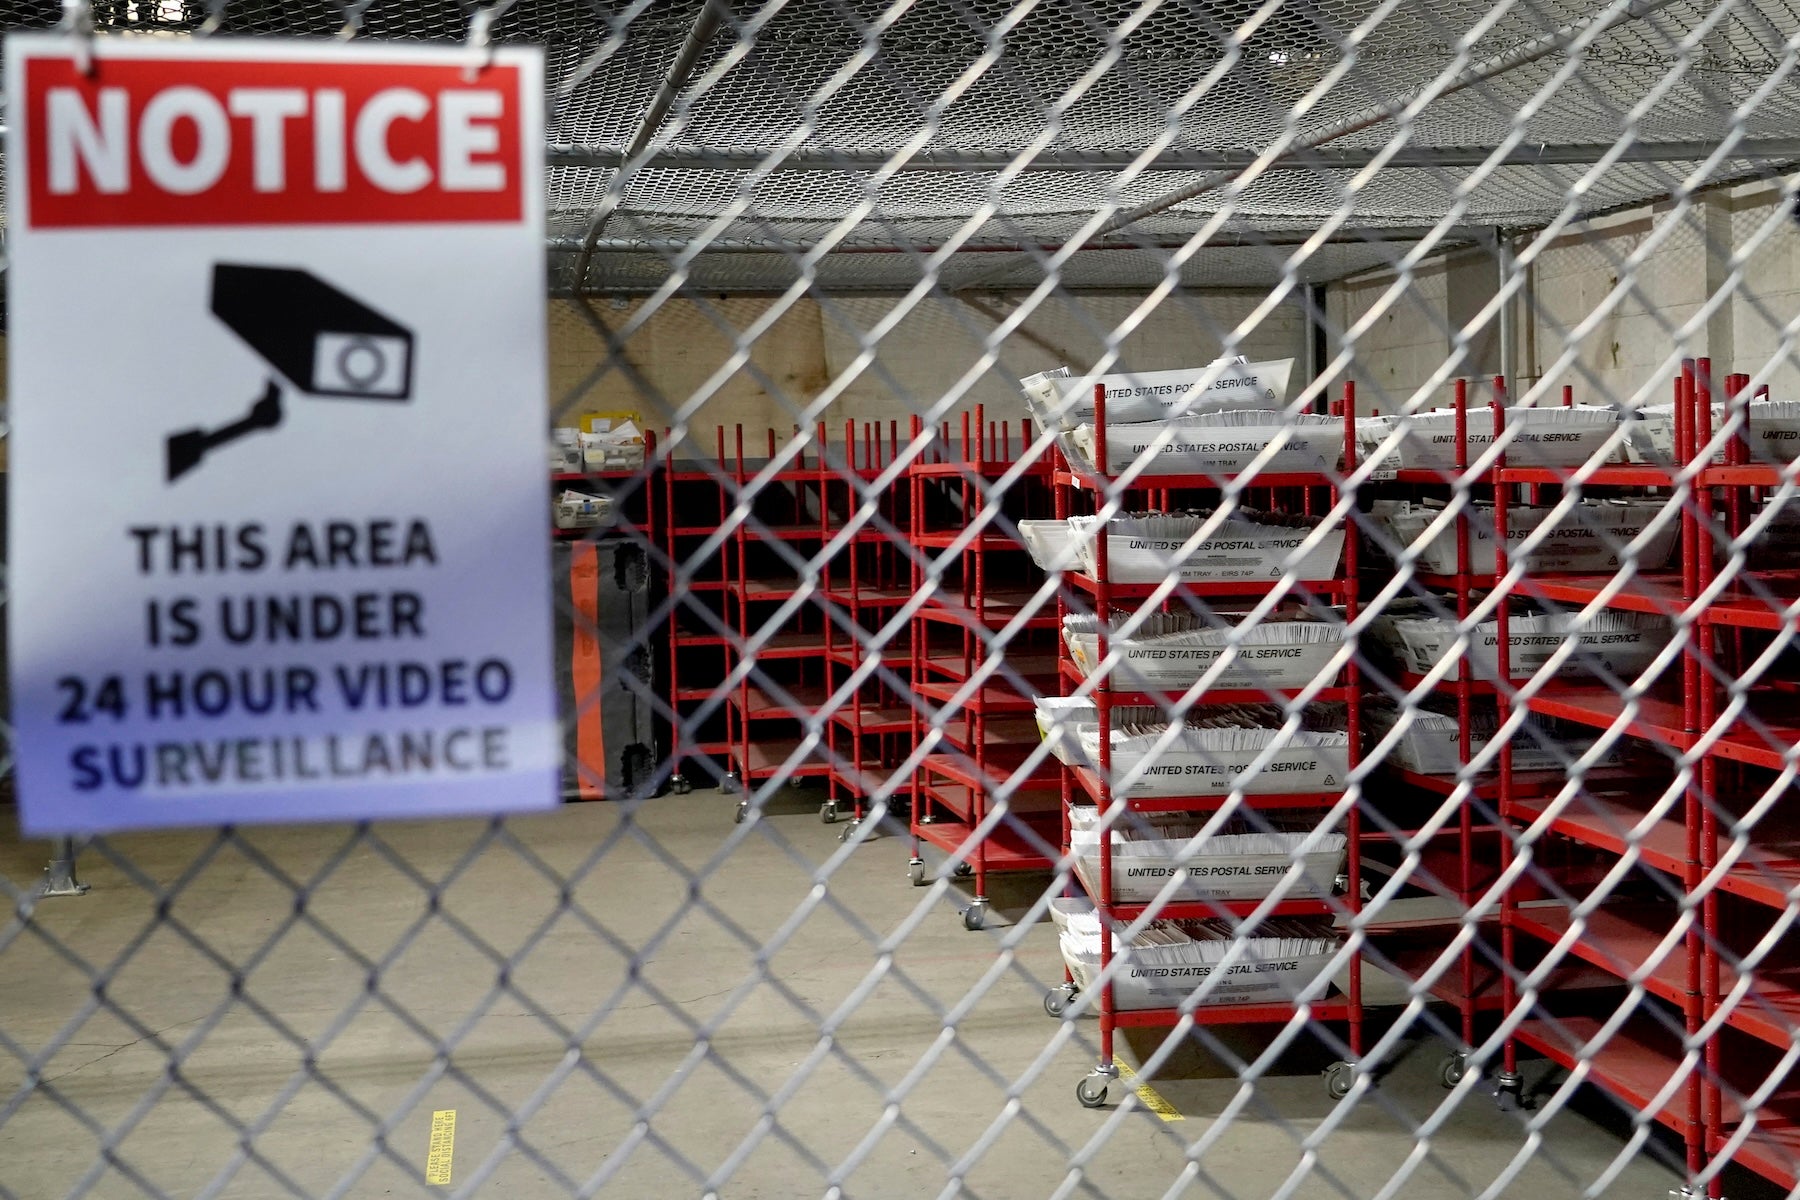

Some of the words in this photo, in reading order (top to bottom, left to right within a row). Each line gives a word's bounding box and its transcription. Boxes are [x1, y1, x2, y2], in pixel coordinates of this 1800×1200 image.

[45, 86, 507, 195] NOTICE
[1135, 386, 1172, 396] STATES
[1216, 376, 1258, 389] SERVICE
[1542, 433, 1583, 442] SERVICE
[1762, 431, 1797, 440] UNITED
[1176, 444, 1216, 453] STATES
[1218, 443, 1259, 452] POSTAL
[128, 523, 268, 576] THIS
[284, 518, 440, 569] AREA
[1130, 540, 1168, 550] UNITED
[1214, 541, 1256, 550] POSTAL
[145, 598, 202, 648] IS
[219, 592, 427, 643] UNDER
[1523, 636, 1560, 646] STATES
[1601, 634, 1640, 644] SERVICE
[1128, 650, 1168, 659] UNITED
[1169, 650, 1210, 659] STATES
[1256, 648, 1302, 658] SERVICE
[56, 674, 128, 725] 24
[146, 667, 323, 719] HOUR
[335, 659, 514, 710] VIDEO
[69, 726, 511, 792] SURVEILLANCE
[1184, 765, 1225, 774] STATES
[1271, 762, 1317, 772] SERVICE
[1128, 868, 1166, 876] UNITED
[1168, 868, 1208, 876] STES
[1210, 867, 1252, 876] POSTAL
[1254, 866, 1293, 875] SERVIC
[1131, 968, 1168, 978] UNITED
[1170, 968, 1211, 976] STATES
[1255, 962, 1298, 972] SERVICE
[432, 1132, 442, 1153] STAND
[441, 1122, 454, 1158] DISTANCING
[428, 1154, 440, 1177] PLEASE
[439, 1159, 450, 1182] SOCIAL
